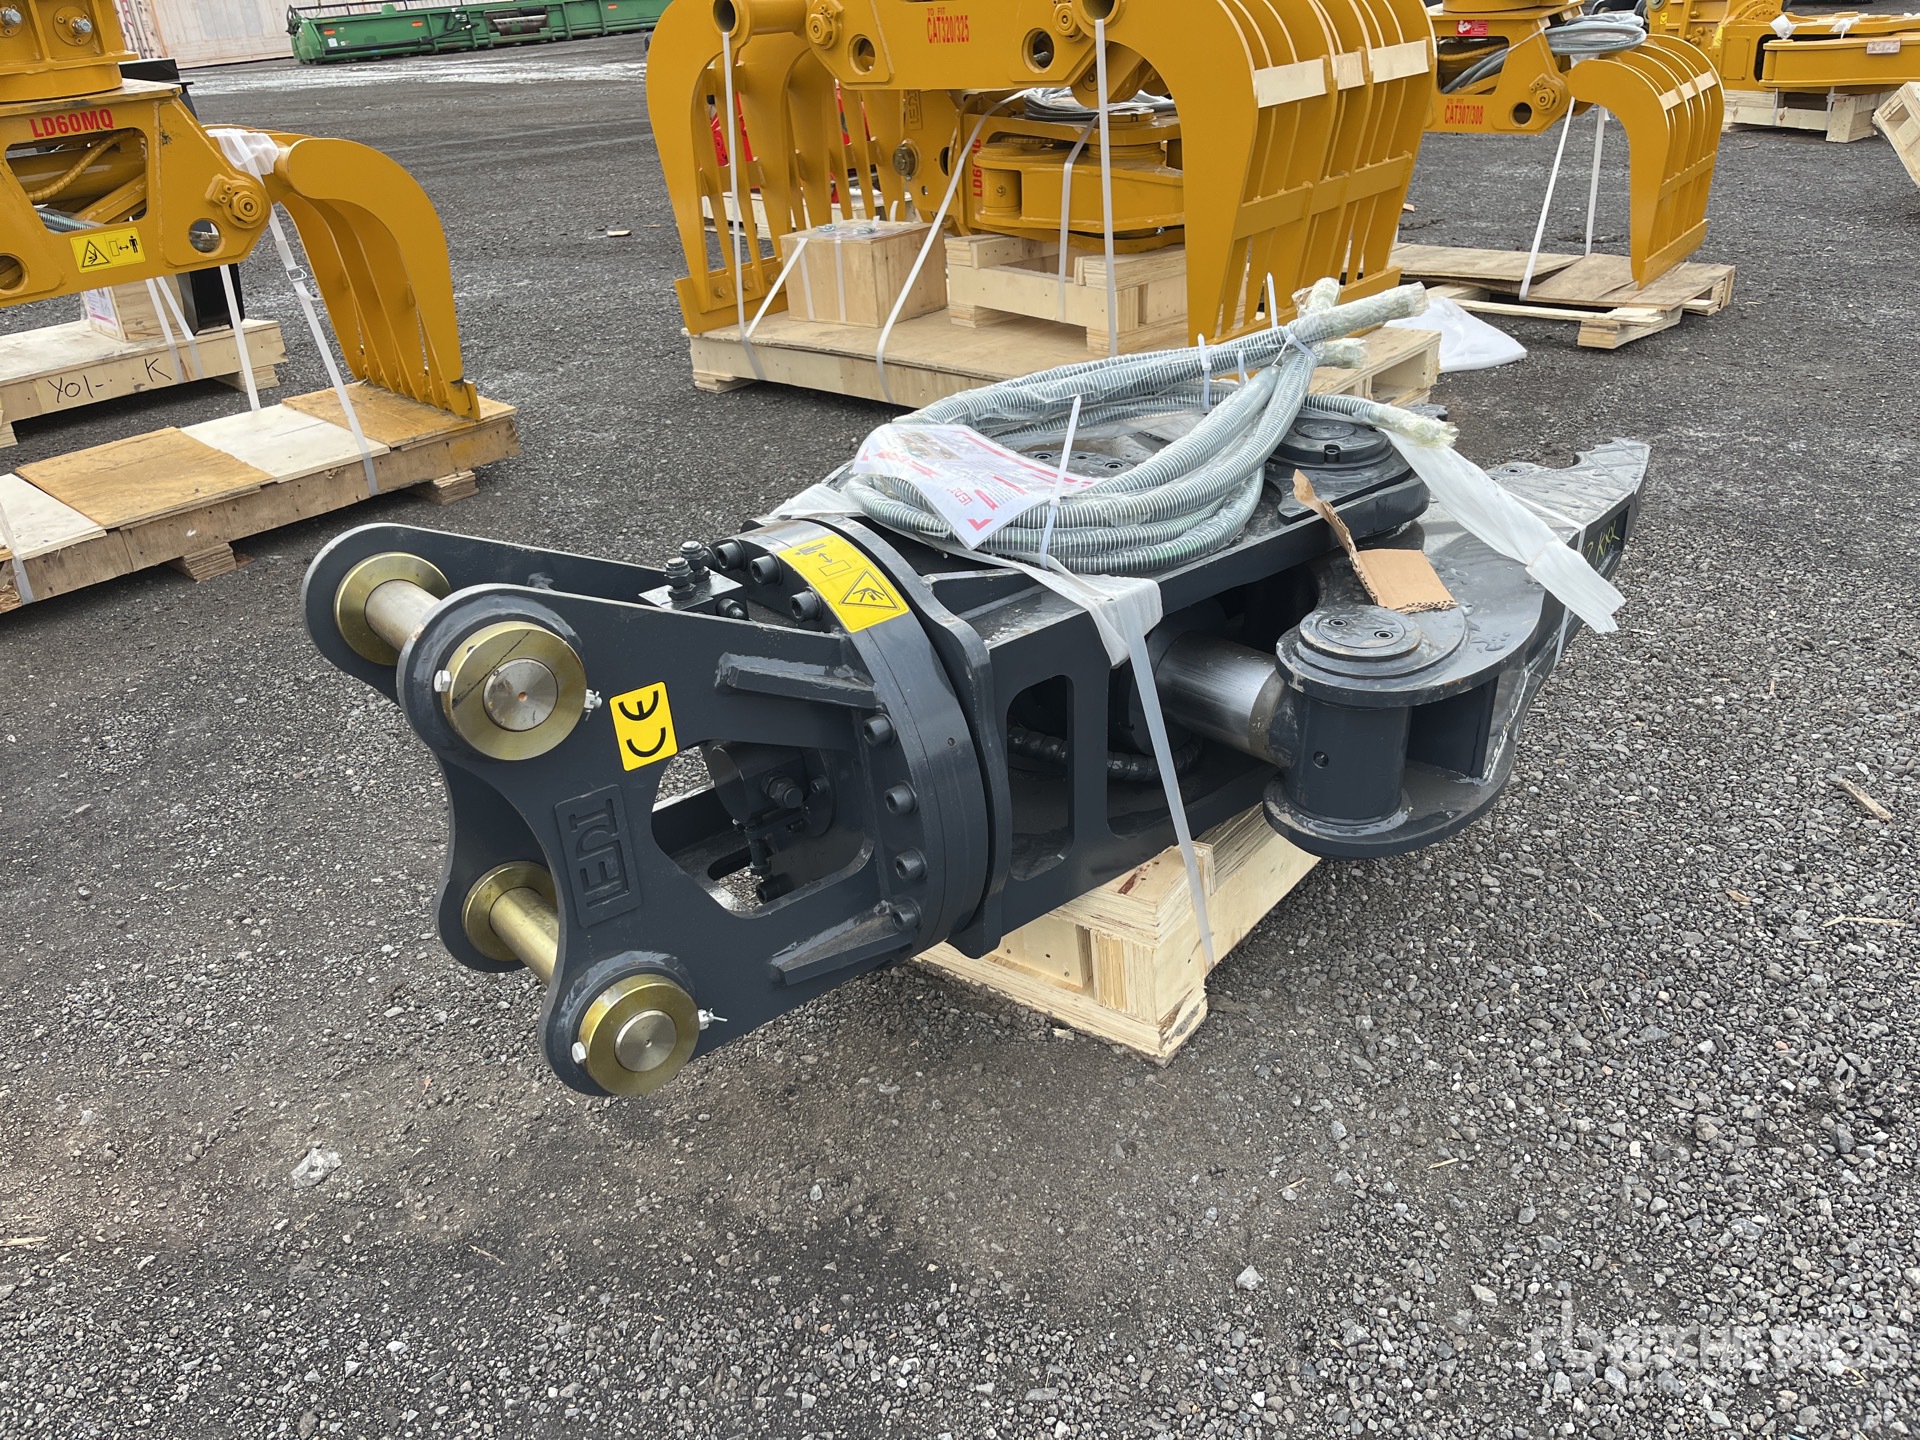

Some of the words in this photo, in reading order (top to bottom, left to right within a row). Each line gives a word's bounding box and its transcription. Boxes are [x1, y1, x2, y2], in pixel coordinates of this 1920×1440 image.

[926, 15, 969, 44] CAT320/325
[29, 108, 114, 138] LD60MQ
[144, 357, 172, 383] K
[618, 690, 666, 758] CE
